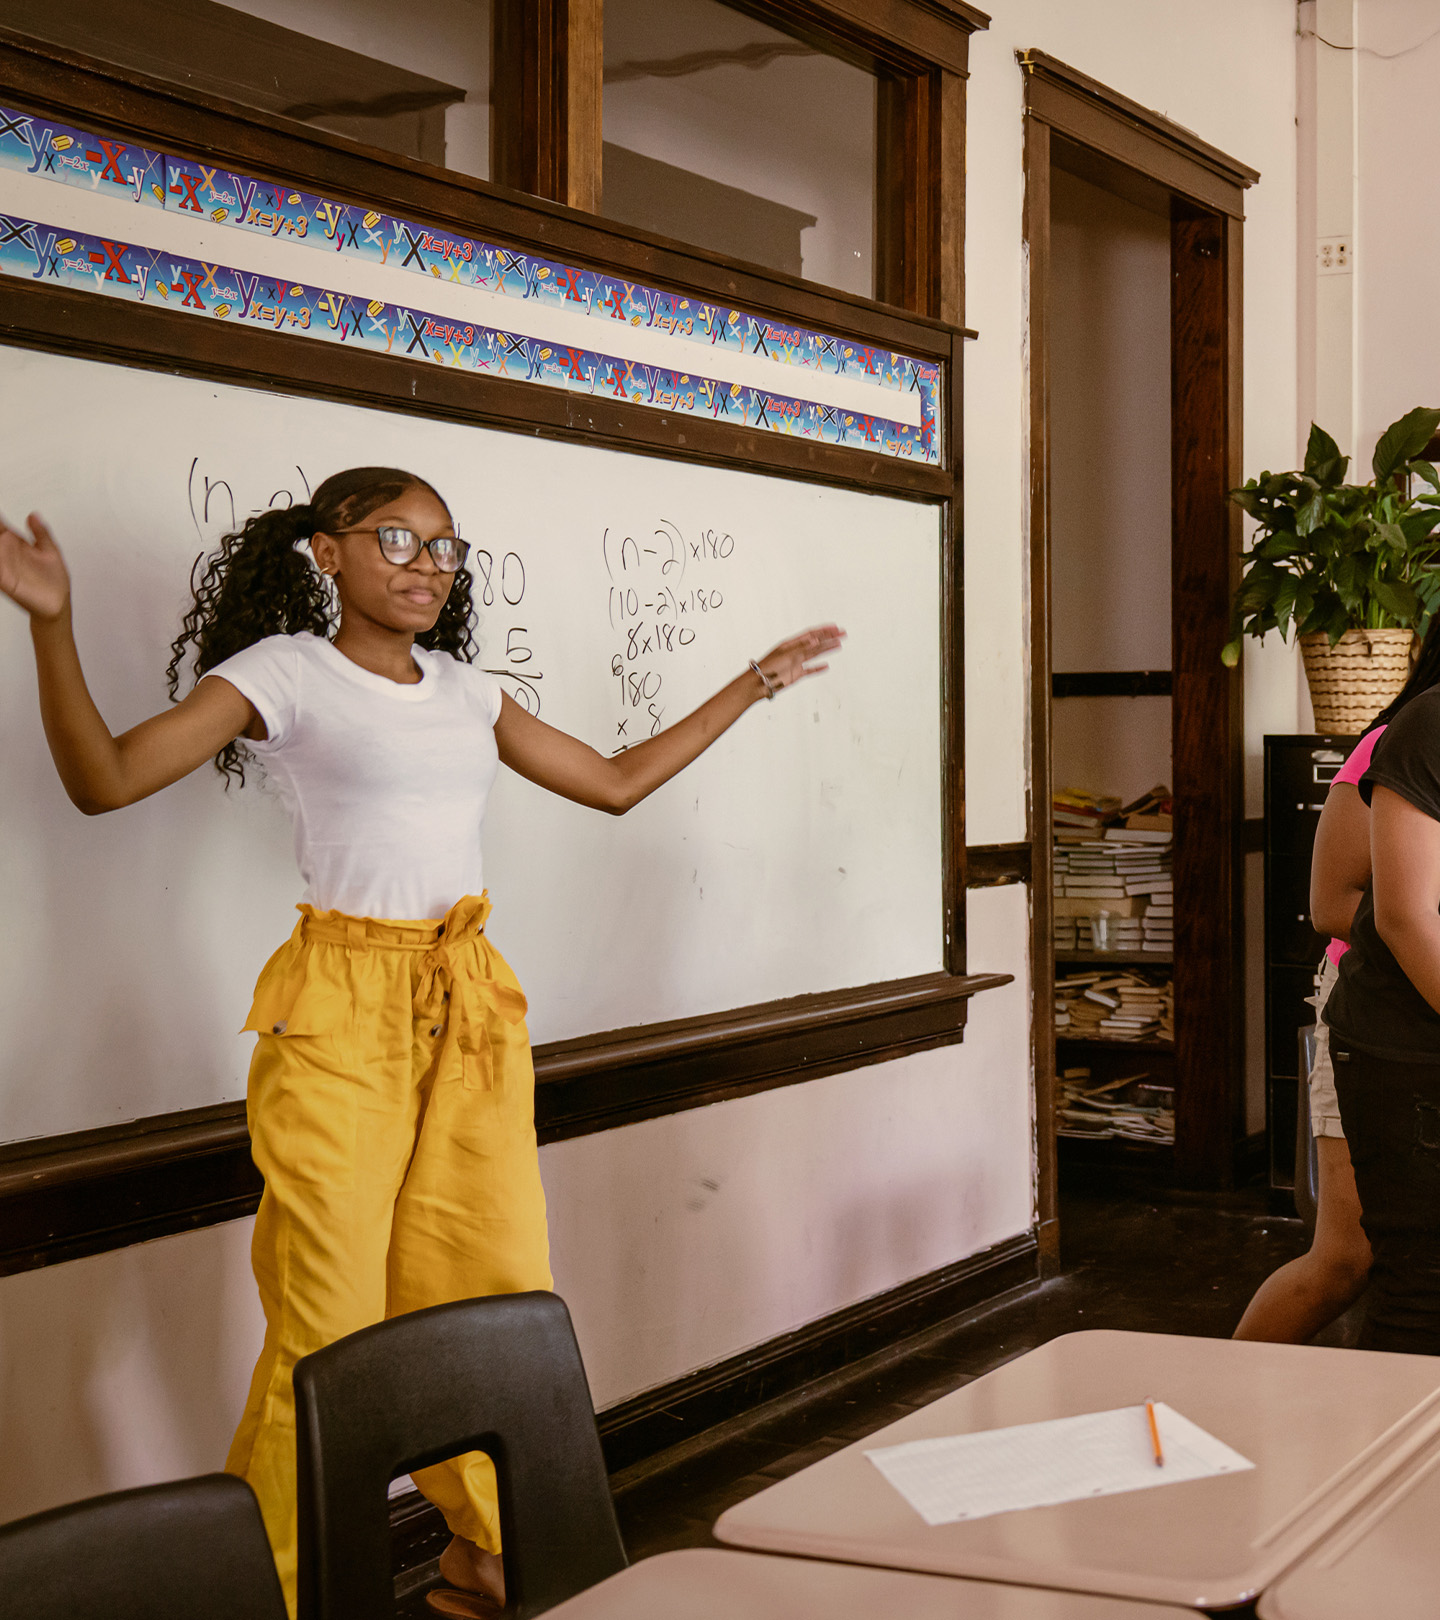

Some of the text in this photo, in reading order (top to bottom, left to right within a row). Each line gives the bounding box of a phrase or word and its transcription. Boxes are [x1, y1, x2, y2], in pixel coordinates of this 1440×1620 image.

[246, 206, 308, 238] x=y+3
[422, 234, 473, 262] x=y+3
[250, 301, 311, 330] x=y+3
[653, 313, 693, 336] x=y+3
[425, 320, 474, 347] x=y+3
[766, 326, 800, 347] x=y+3
[655, 389, 694, 410] x=y+3
[767, 398, 800, 417] x=y+3
[506, 627, 532, 663] 5
[611, 653, 624, 677] 6
[621, 671, 662, 707] 180
[647, 703, 666, 737] 8
